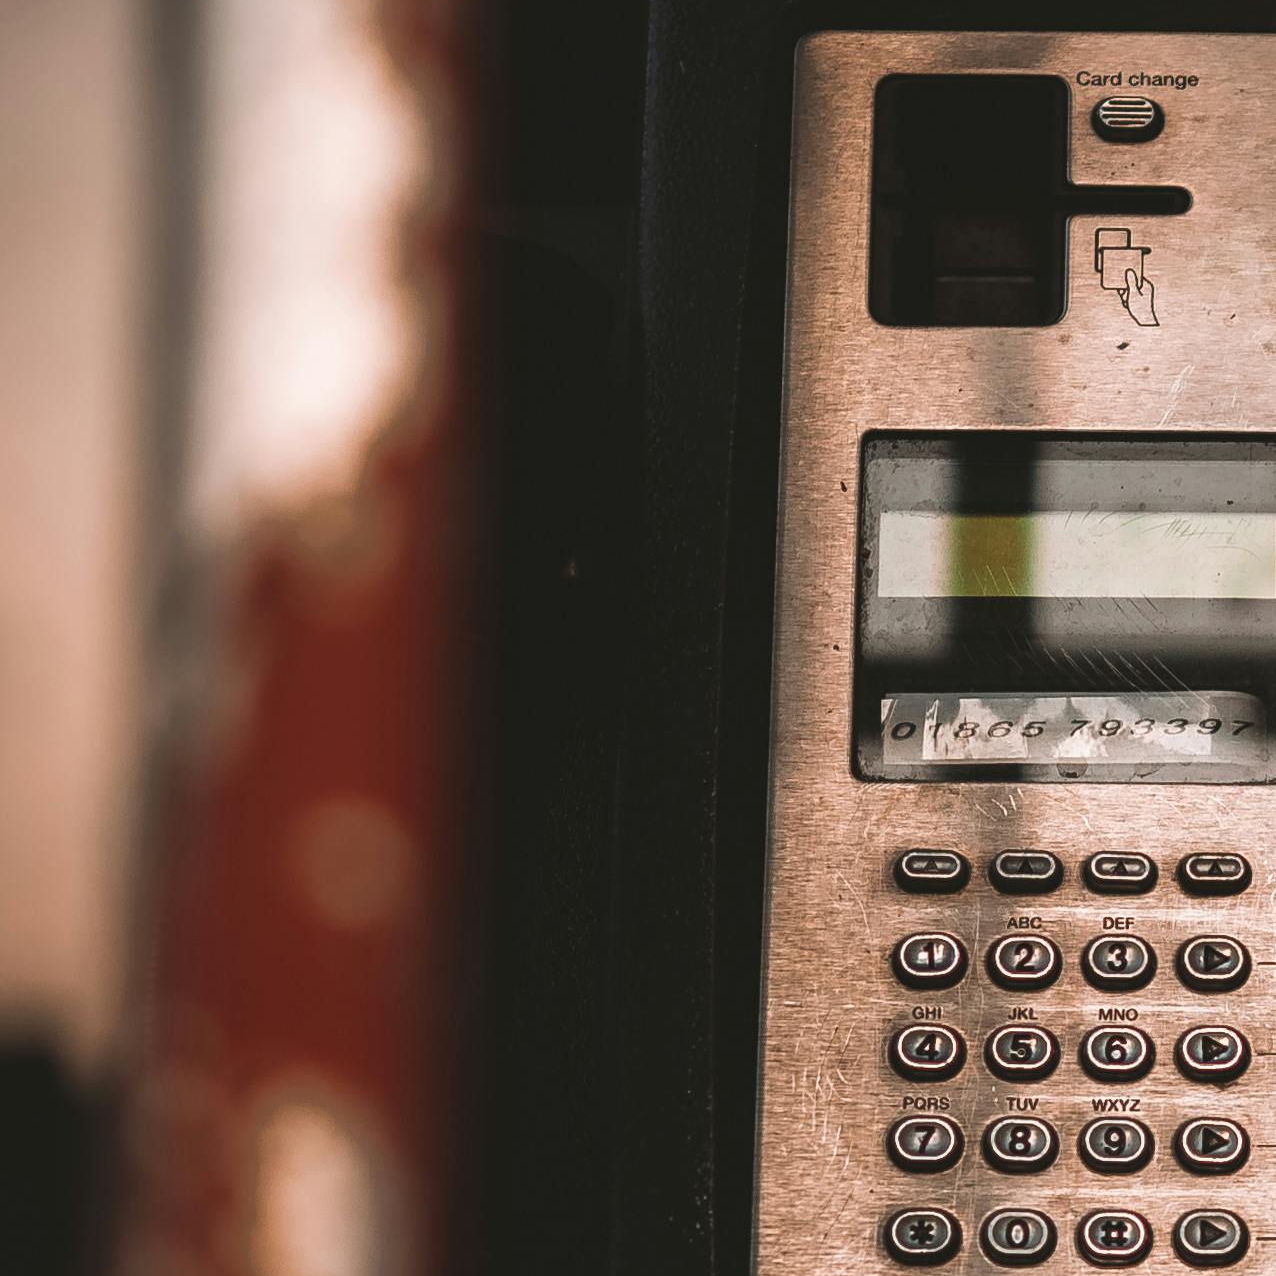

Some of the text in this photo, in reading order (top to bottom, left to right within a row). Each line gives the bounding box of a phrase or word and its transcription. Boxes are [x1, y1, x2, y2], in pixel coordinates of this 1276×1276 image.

[1076, 70, 1199, 90] Card change
[891, 716, 1255, 739] 01865 793397
[1007, 916, 1043, 930] ABC
[1102, 917, 1135, 930] DEF
[924, 941, 935, 969] 1
[1014, 942, 1035, 971] 2
[1107, 943, 1128, 971] 3
[912, 1007, 942, 1020] GHI
[1007, 1007, 1038, 1021] JKL
[1099, 1008, 1138, 1021] MNO
[916, 1033, 938, 1061] 4
[1009, 1033, 1033, 1061] 5
[1105, 1035, 1128, 1063] 6
[903, 1097, 950, 1111] PQRS
[1007, 1098, 1039, 1111] TUV
[1091, 1098, 1141, 1112] WXYZ
[914, 1125, 935, 1154] 7
[1009, 1125, 1032, 1155] 8
[1103, 1126, 1127, 1155] 9
[1005, 1219, 1030, 1248] 0
